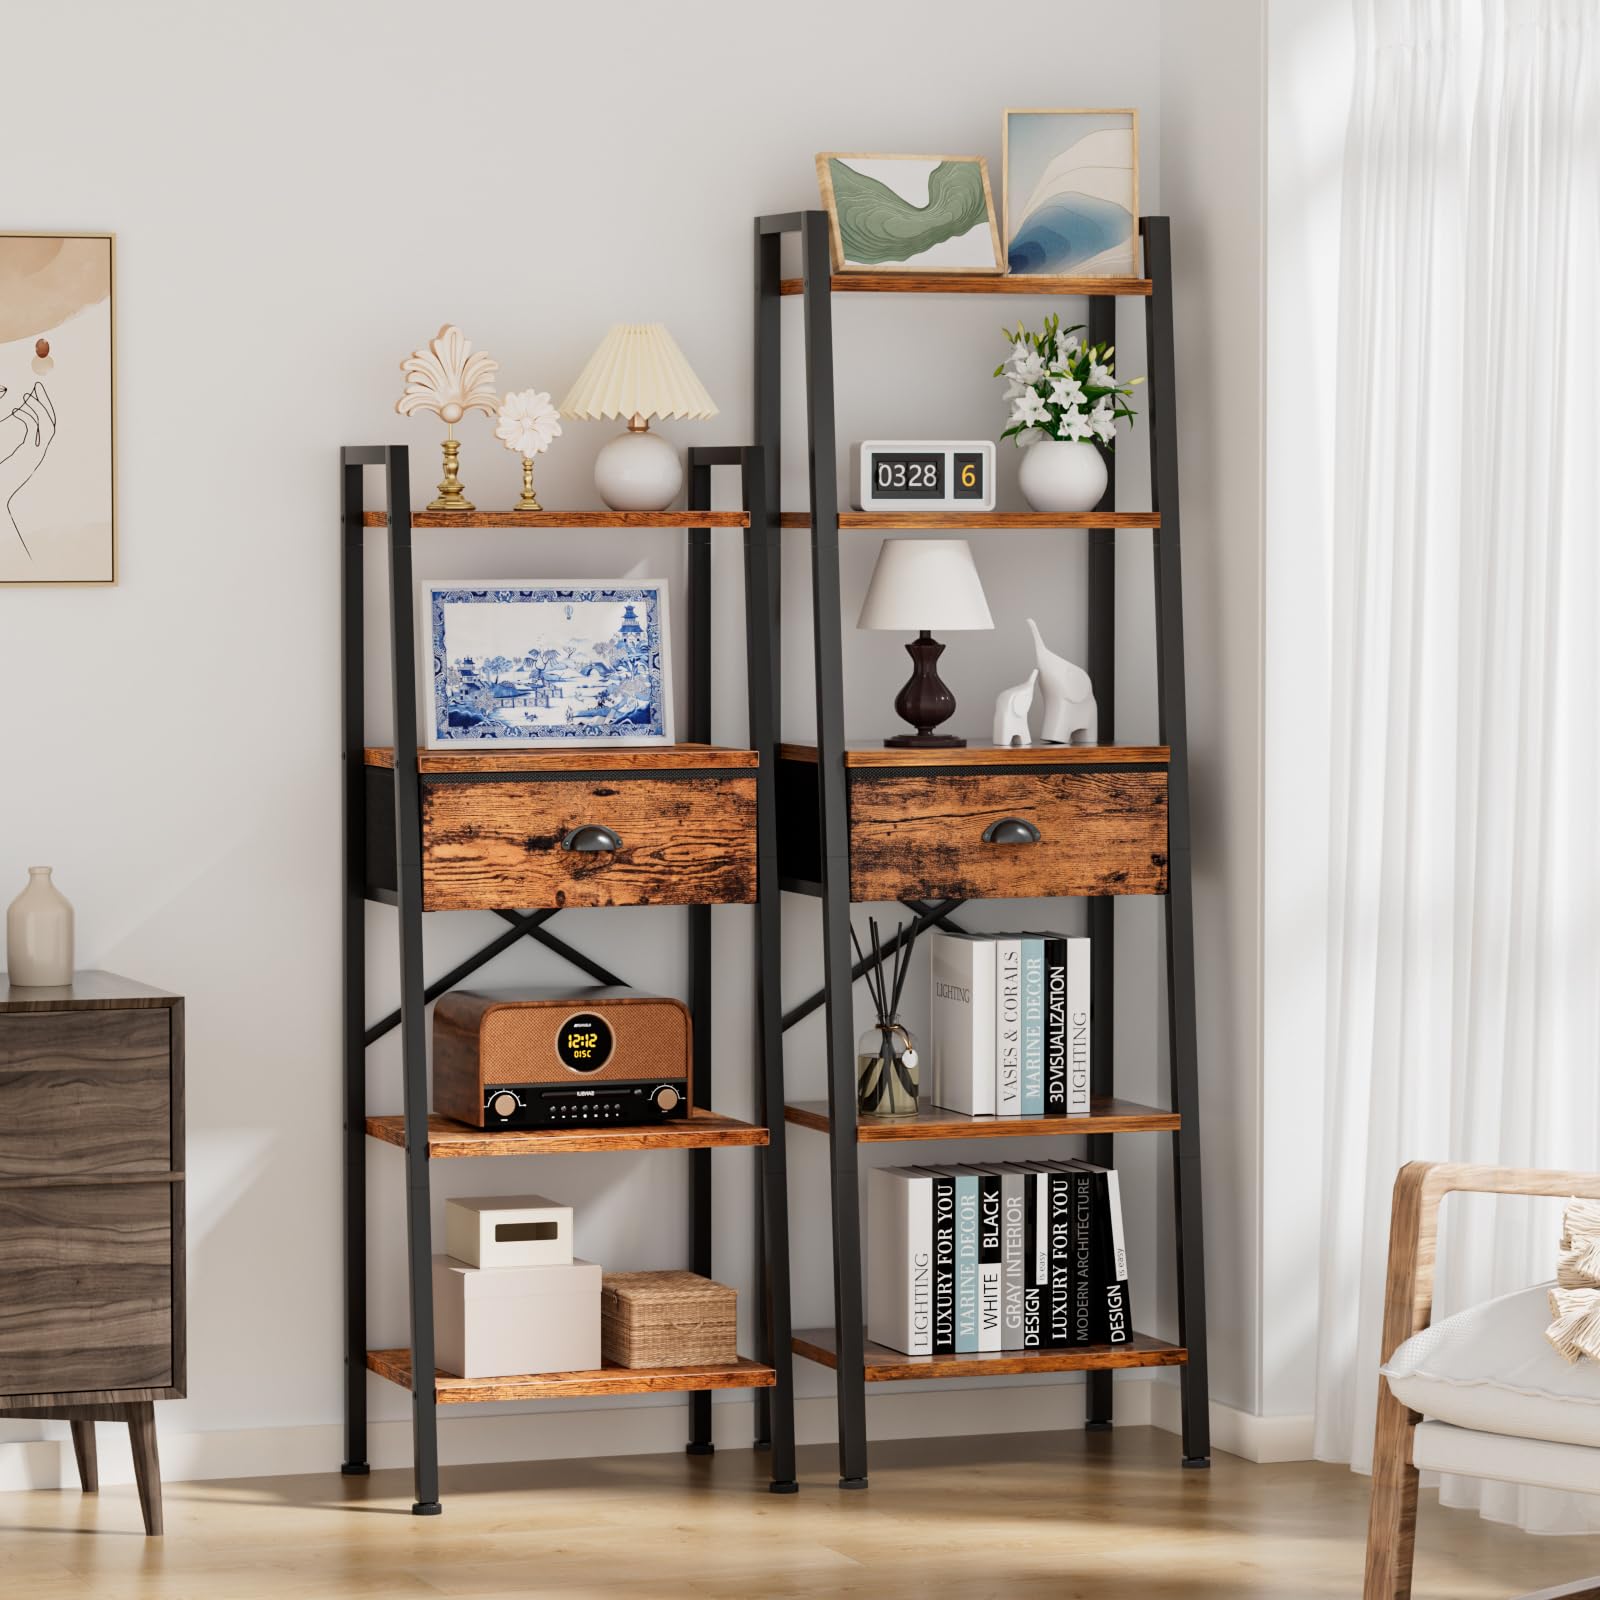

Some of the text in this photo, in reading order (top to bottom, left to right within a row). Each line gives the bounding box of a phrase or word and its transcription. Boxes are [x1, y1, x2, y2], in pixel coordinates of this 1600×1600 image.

[961, 464, 976, 487] 6
[936, 982, 970, 1004] LIGHTING
[1003, 951, 1018, 1102] VASES & CORALS
[1026, 958, 1041, 1098] MARINE DECOR
[1049, 966, 1064, 1103] 3D VISUALIZATION
[568, 1033, 598, 1048] 12:12
[1072, 1012, 1087, 1104] LIGHTING
[937, 1184, 953, 1346] LUXURY FOR YOU
[960, 1194, 976, 1336] MARINE DECOR
[983, 1190, 999, 1248] BLACK
[1006, 1196, 1022, 1329] GRAY INTERIOR
[1039, 1251, 1047, 1272] easy
[1052, 1180, 1068, 1340] LUXURY FOR YOU
[1076, 1177, 1090, 1341] MODERN ARCHITECTURE
[914, 1253, 929, 1347] LIGHTING
[983, 1273, 998, 1330] WHITE
[1025, 1288, 1040, 1346] DESIGN
[1106, 1284, 1126, 1343] DESIGN
